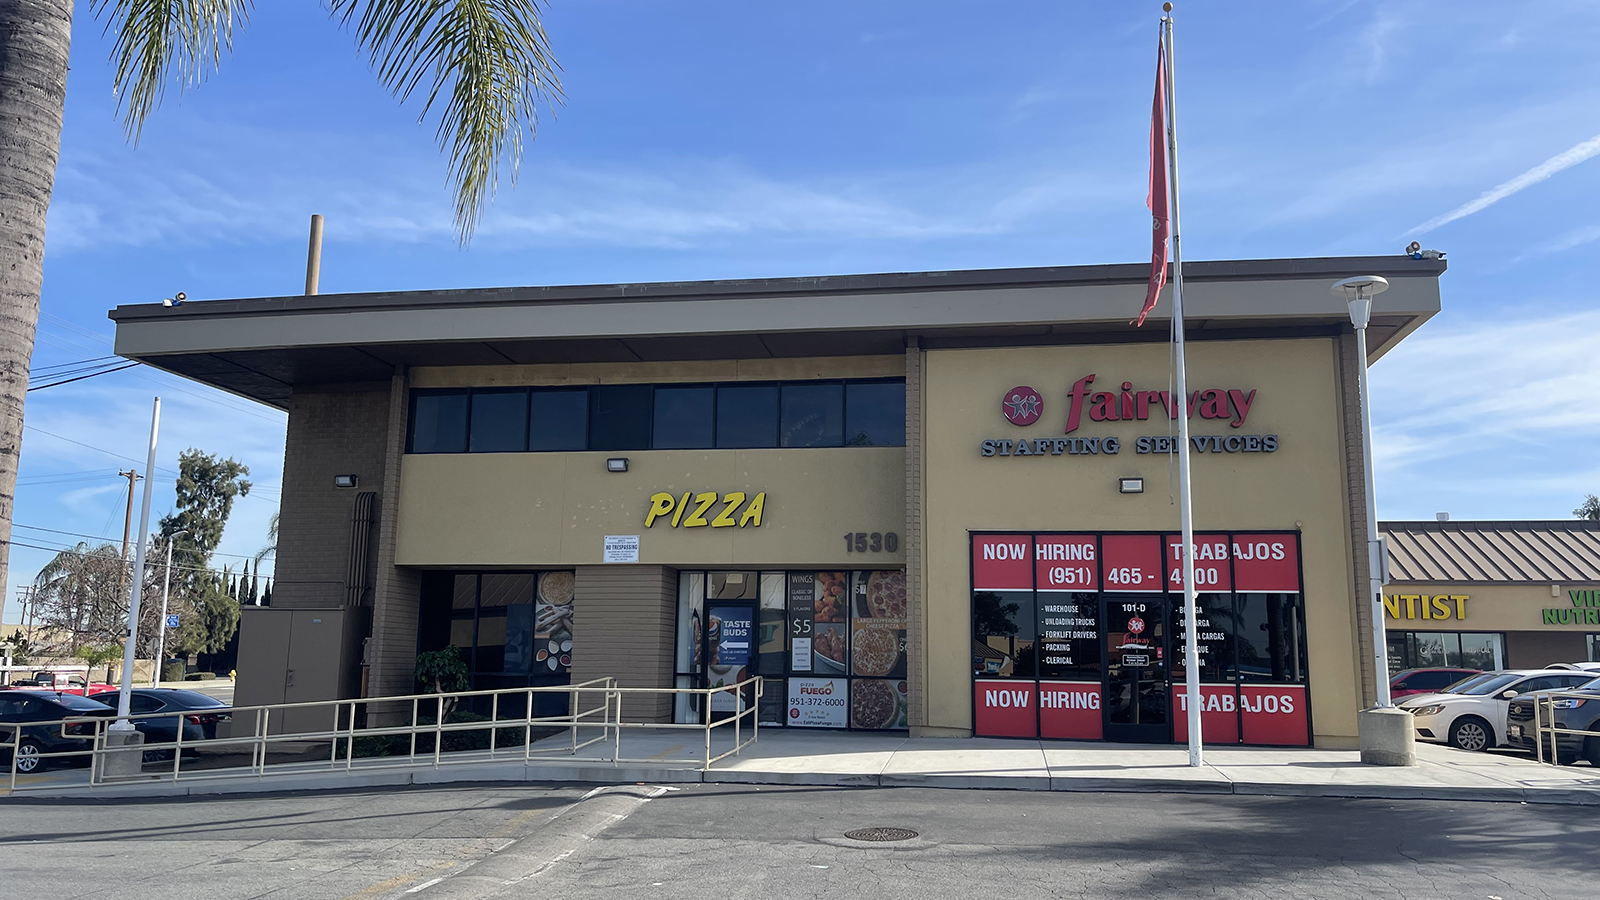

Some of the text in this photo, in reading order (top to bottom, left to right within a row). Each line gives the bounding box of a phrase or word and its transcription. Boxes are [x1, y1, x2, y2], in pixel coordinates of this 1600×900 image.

[1065, 374, 1257, 433] fairway
[981, 437, 1121, 456] STAFFING
[644, 491, 767, 528] PIZZA
[843, 532, 898, 553] 1530
[983, 543, 1094, 561] NOW HIRING
[791, 575, 813, 583] WINGS
[1049, 567, 1091, 585] (951)
[1108, 567, 1142, 584] 465
[1170, 568, 1218, 584] 400
[1045, 605, 1079, 613] WAREHOUSE
[1122, 604, 1146, 612] 101-D
[1542, 608, 1600, 625] NUTR
[723, 620, 750, 628] TASTE
[1045, 618, 1095, 626] UNLOADING TRUCKS
[793, 618, 811, 635] $5
[1073, 631, 1097, 639] DRIVERS
[1201, 632, 1225, 640] CARGAS
[1046, 643, 1070, 651] PACKING
[1046, 656, 1073, 664] CLERICAL
[801, 687, 832, 695] FUEGO
[790, 697, 845, 706] 951-372-6000
[985, 690, 1100, 710] NOW HIRING
